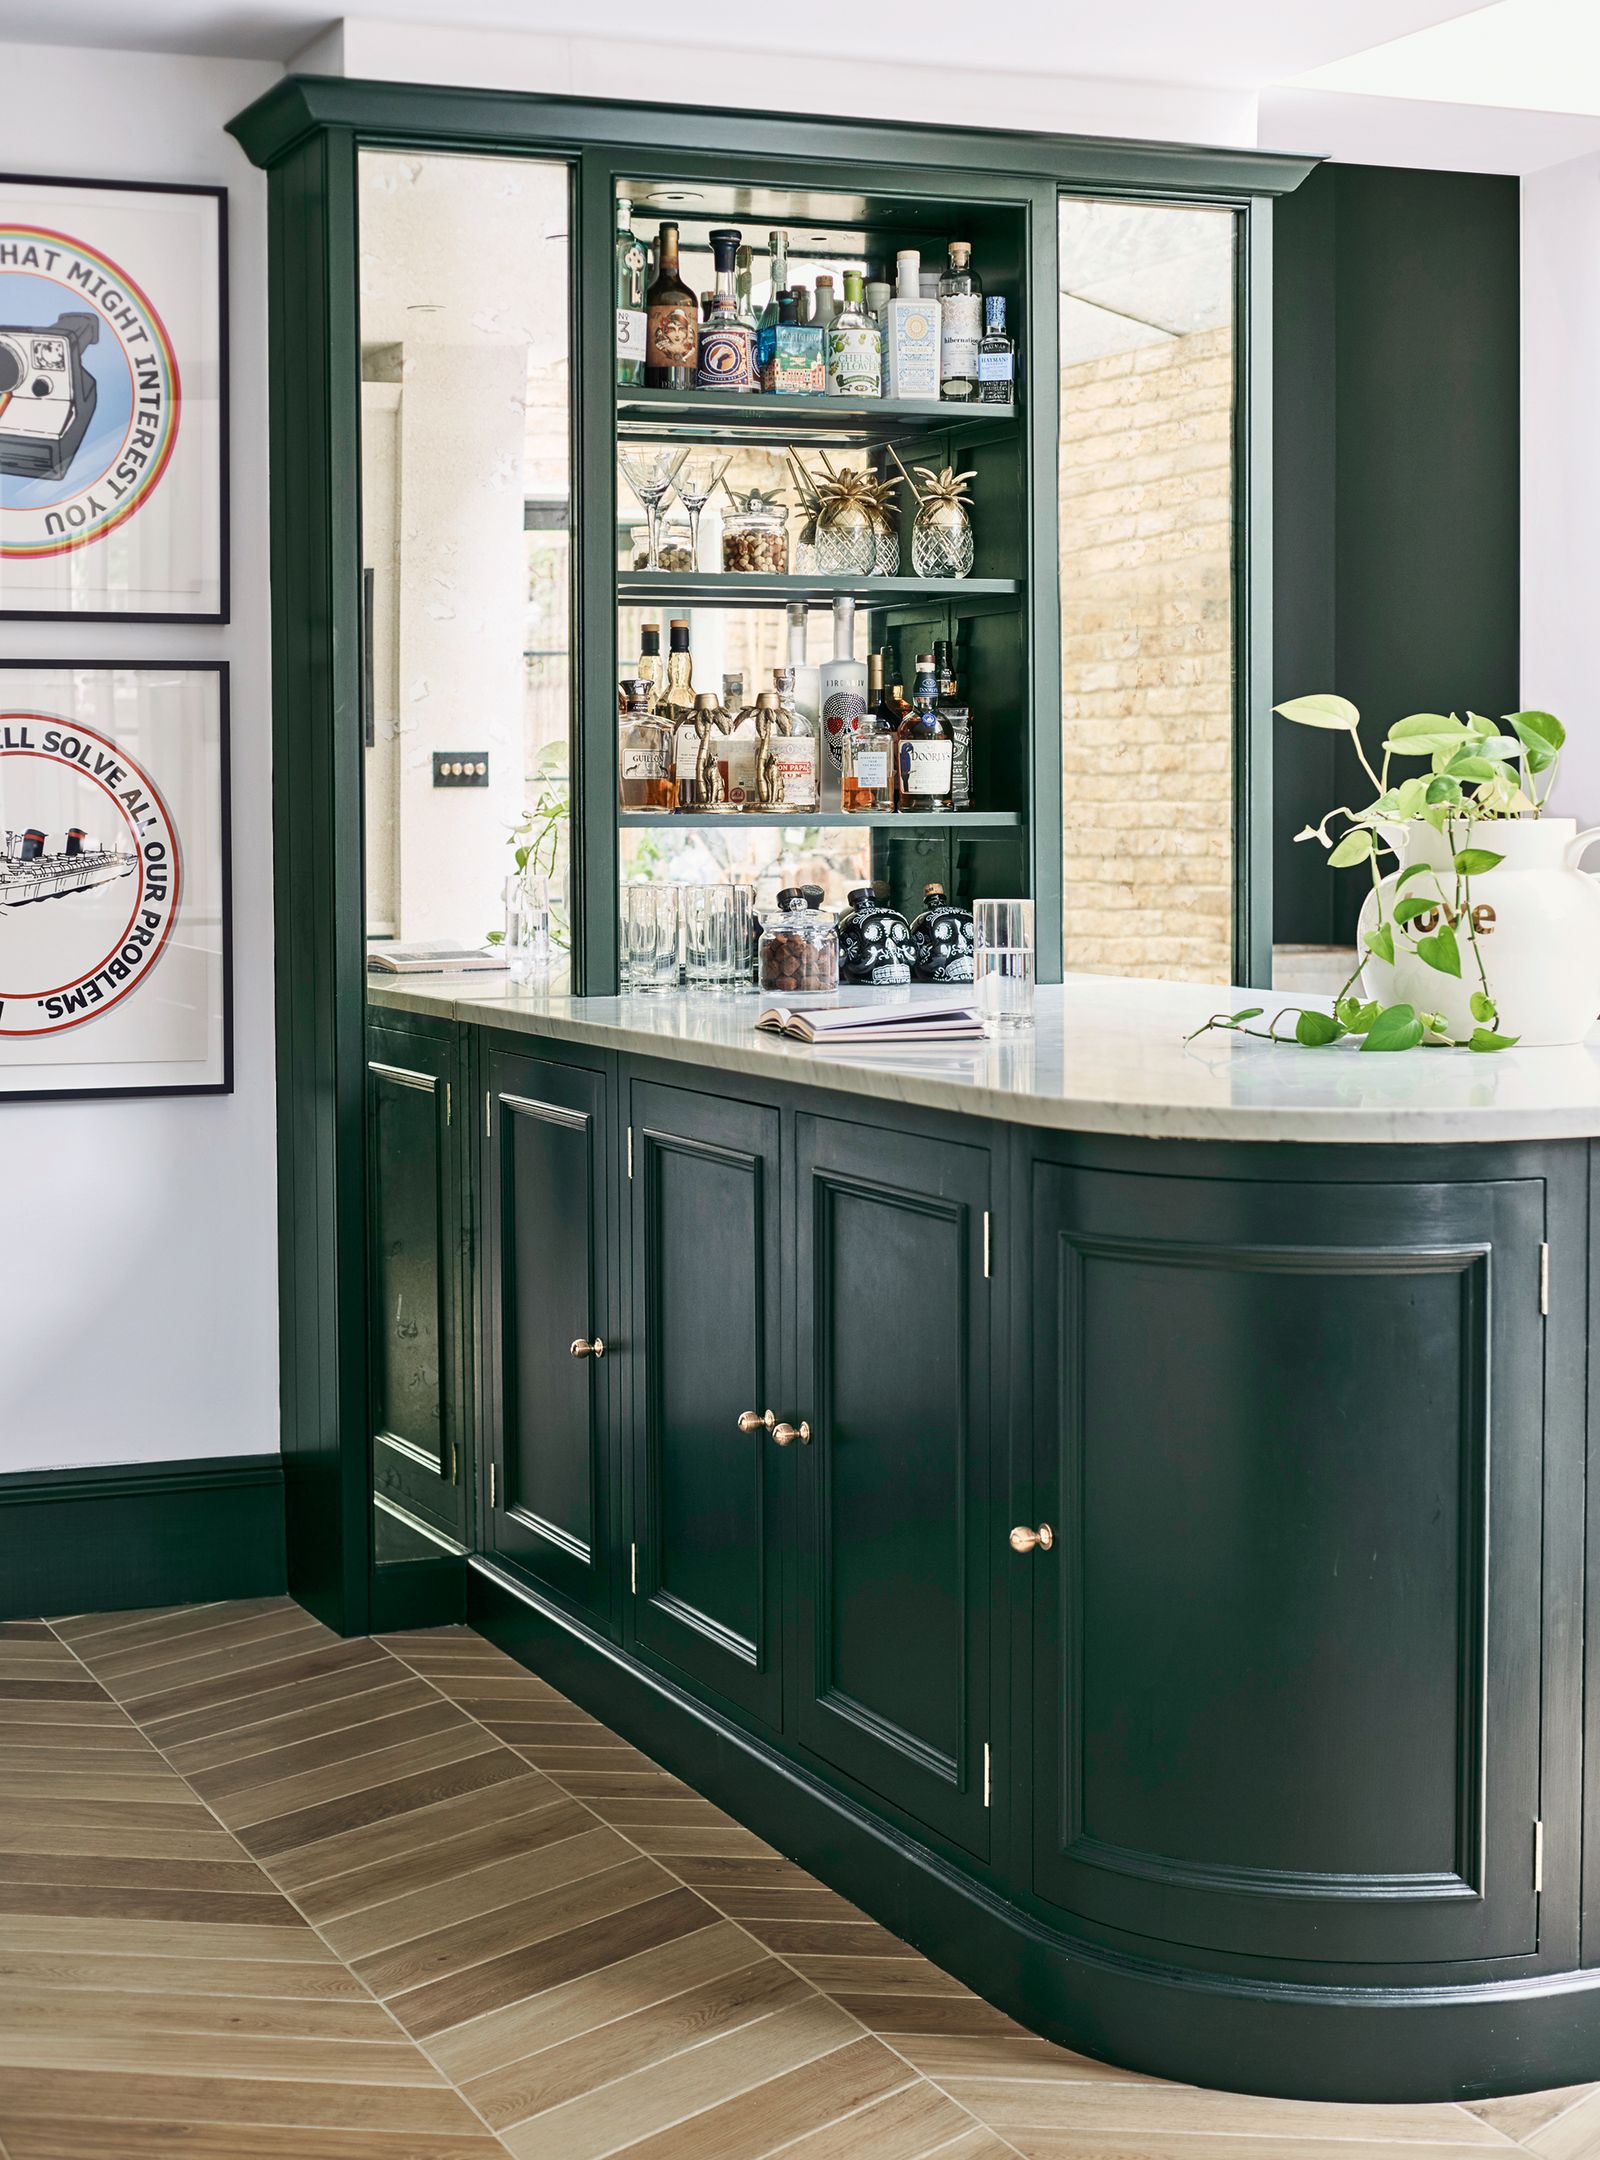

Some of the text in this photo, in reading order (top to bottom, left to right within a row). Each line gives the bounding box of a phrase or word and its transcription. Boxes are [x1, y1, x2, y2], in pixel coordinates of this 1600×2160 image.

[618, 321, 630, 343] 3
[944, 337, 978, 345] hibernatio
[0, 243, 162, 535] HAT MIGHT INTEREST YOU
[0, 727, 167, 1019] LL SOLVE ALL OUR PROBLEMS.
[1400, 892, 1497, 935] ove
